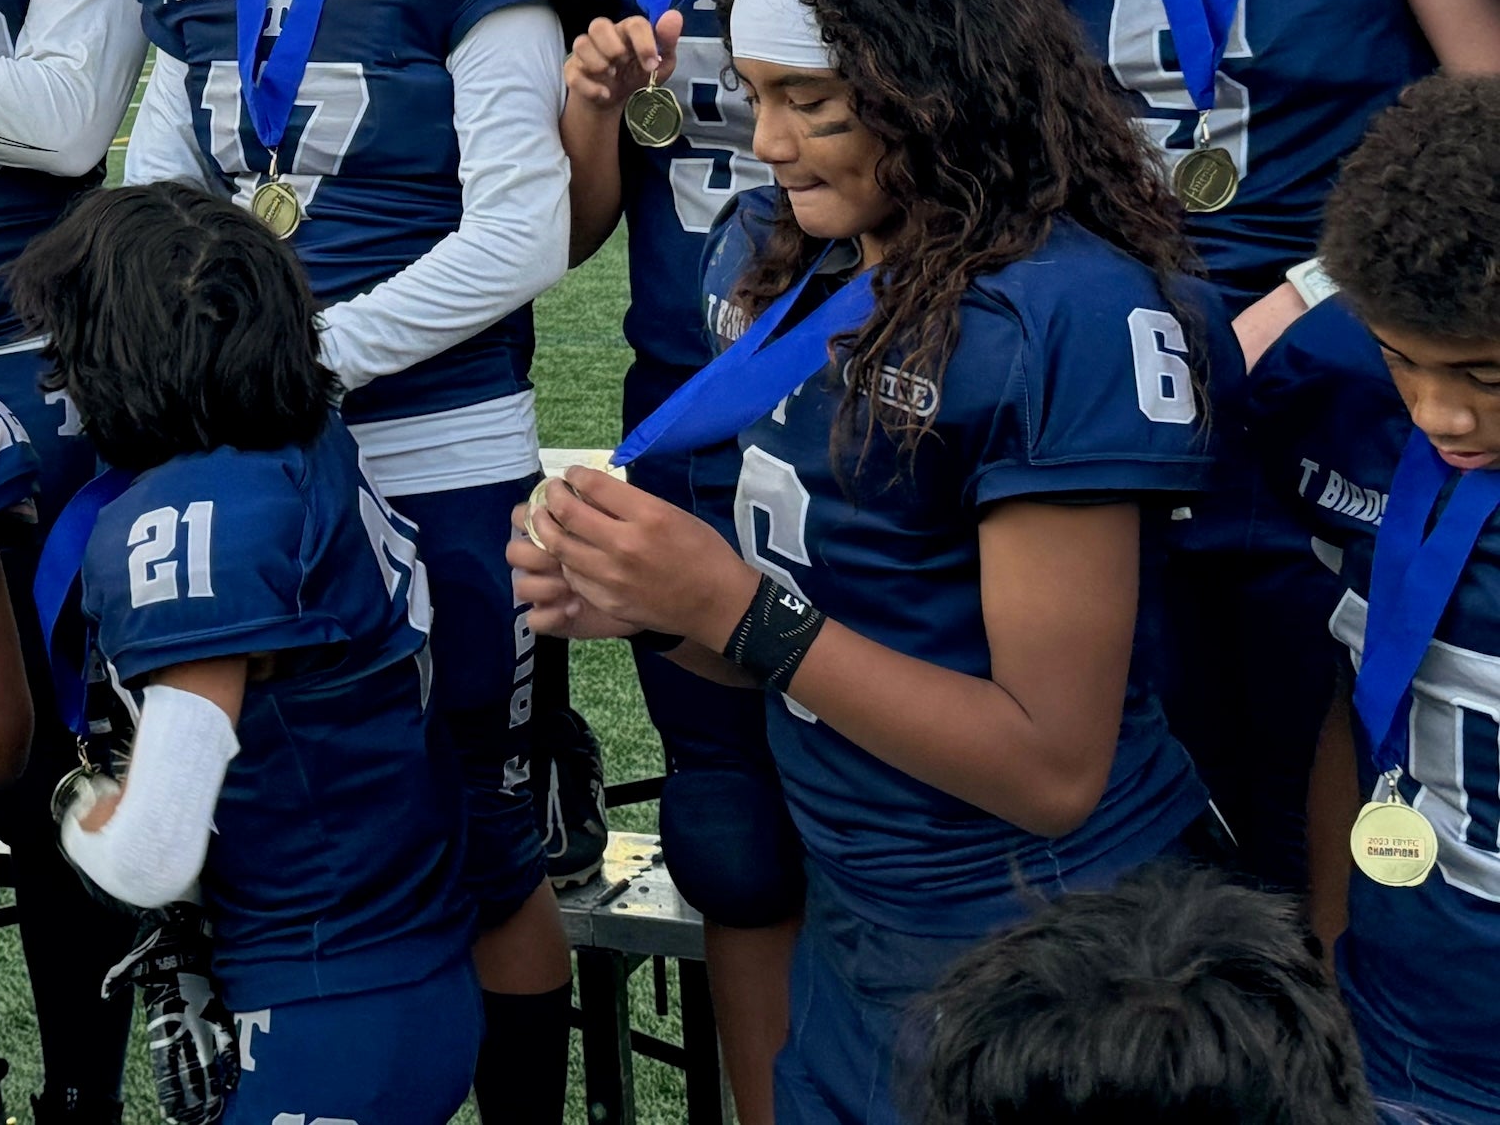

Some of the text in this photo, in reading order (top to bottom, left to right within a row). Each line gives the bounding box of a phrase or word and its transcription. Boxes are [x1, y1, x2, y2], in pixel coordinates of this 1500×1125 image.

[200, 60, 371, 222] 17
[1127, 307, 1197, 424] 6
[1299, 458, 1320, 497] T
[127, 500, 214, 609] 21
[779, 593, 806, 616] KT
[234, 1008, 271, 1072] T
